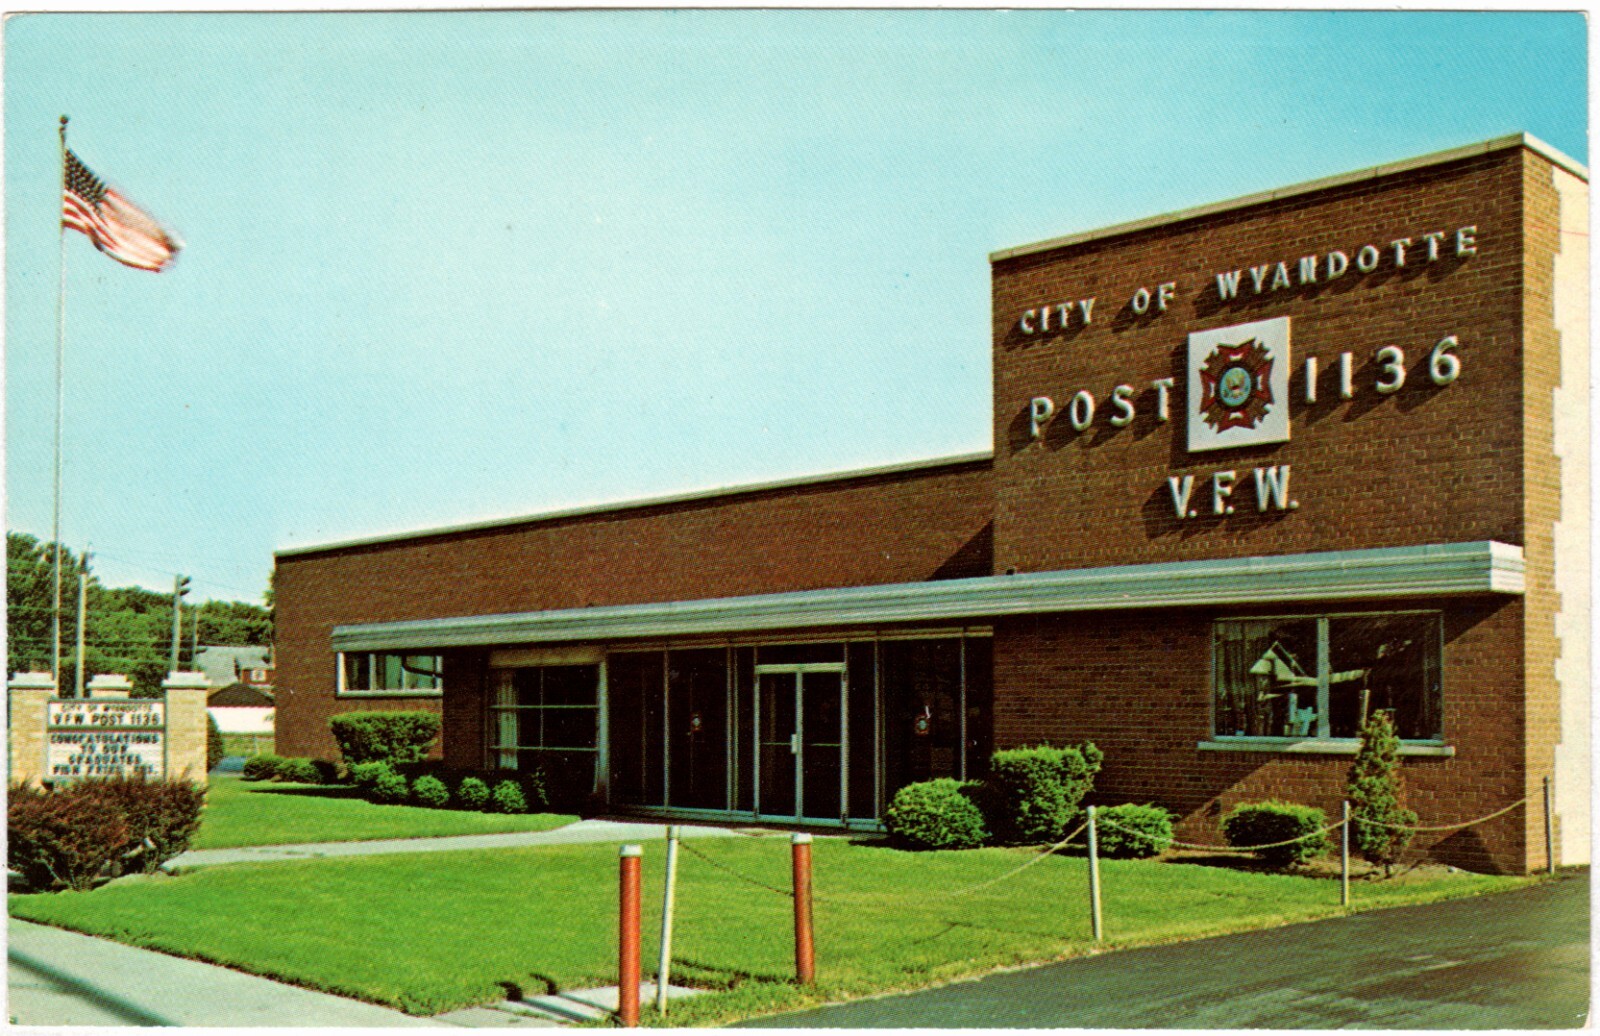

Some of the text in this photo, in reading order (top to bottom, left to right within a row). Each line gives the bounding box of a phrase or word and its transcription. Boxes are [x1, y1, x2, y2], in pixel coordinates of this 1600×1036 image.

[1019, 225, 1479, 334] CITY OF WYANDOTTE
[1030, 335, 1462, 438] POST 1136
[91, 713, 124, 726] POST
[130, 713, 160, 725] 1136
[50, 733, 159, 744] CONGRATULATIONS
[80, 743, 128, 754] TO OUR
[68, 754, 141, 765] GRADUATES
